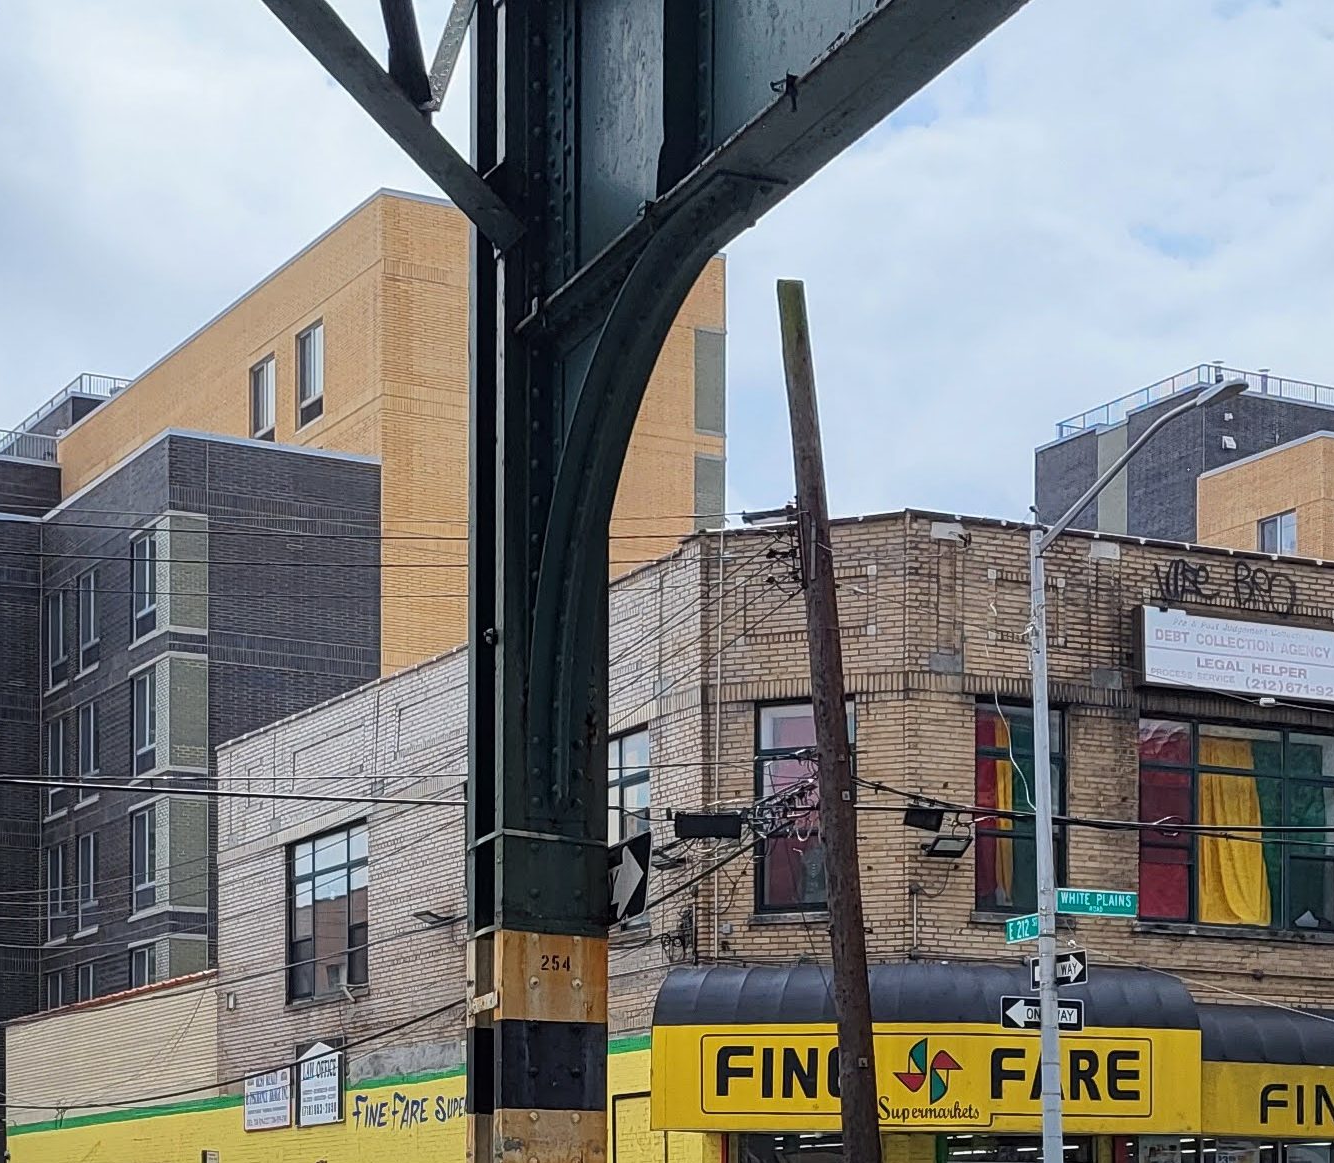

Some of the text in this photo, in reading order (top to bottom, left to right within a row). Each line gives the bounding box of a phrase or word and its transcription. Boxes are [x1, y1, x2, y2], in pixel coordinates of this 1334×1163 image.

[1155, 629, 1332, 660] DEBT COLLECTION AGENCY
[1196, 656, 1308, 679] LEGAL HELPER
[1061, 892, 1132, 908] WHITE PLAINS
[1009, 923, 1014, 940] E
[1017, 920, 1029, 938] 212
[541, 955, 571, 971] 254
[1061, 962, 1077, 975] WAY
[1026, 1007, 1041, 1020] ON
[878, 1096, 980, 1121] Supermarkets
